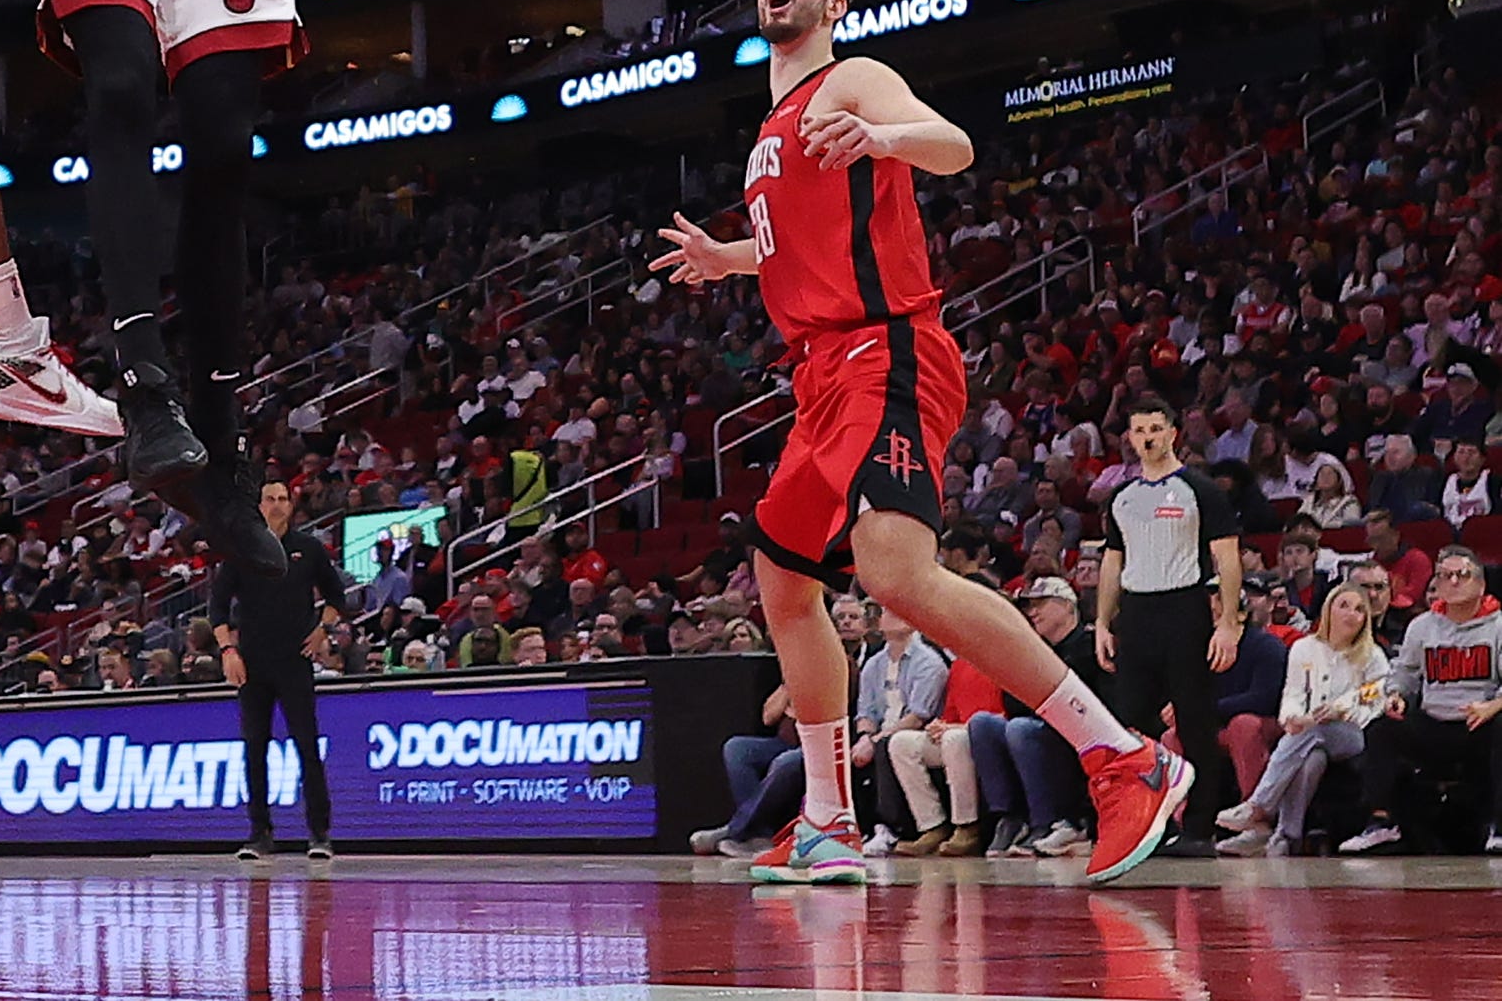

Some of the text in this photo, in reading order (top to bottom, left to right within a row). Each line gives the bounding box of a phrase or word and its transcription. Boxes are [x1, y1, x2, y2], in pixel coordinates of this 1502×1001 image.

[562, 51, 697, 106] CASAMIGOS
[1005, 56, 1174, 108] MEMORIAL HERMANN
[306, 106, 452, 149] CASAMIGOS
[398, 720, 642, 768] DOCUMATION
[407, 780, 458, 804] PRINT
[472, 778, 569, 804] SOFTWARE
[584, 776, 632, 802] VOIP
